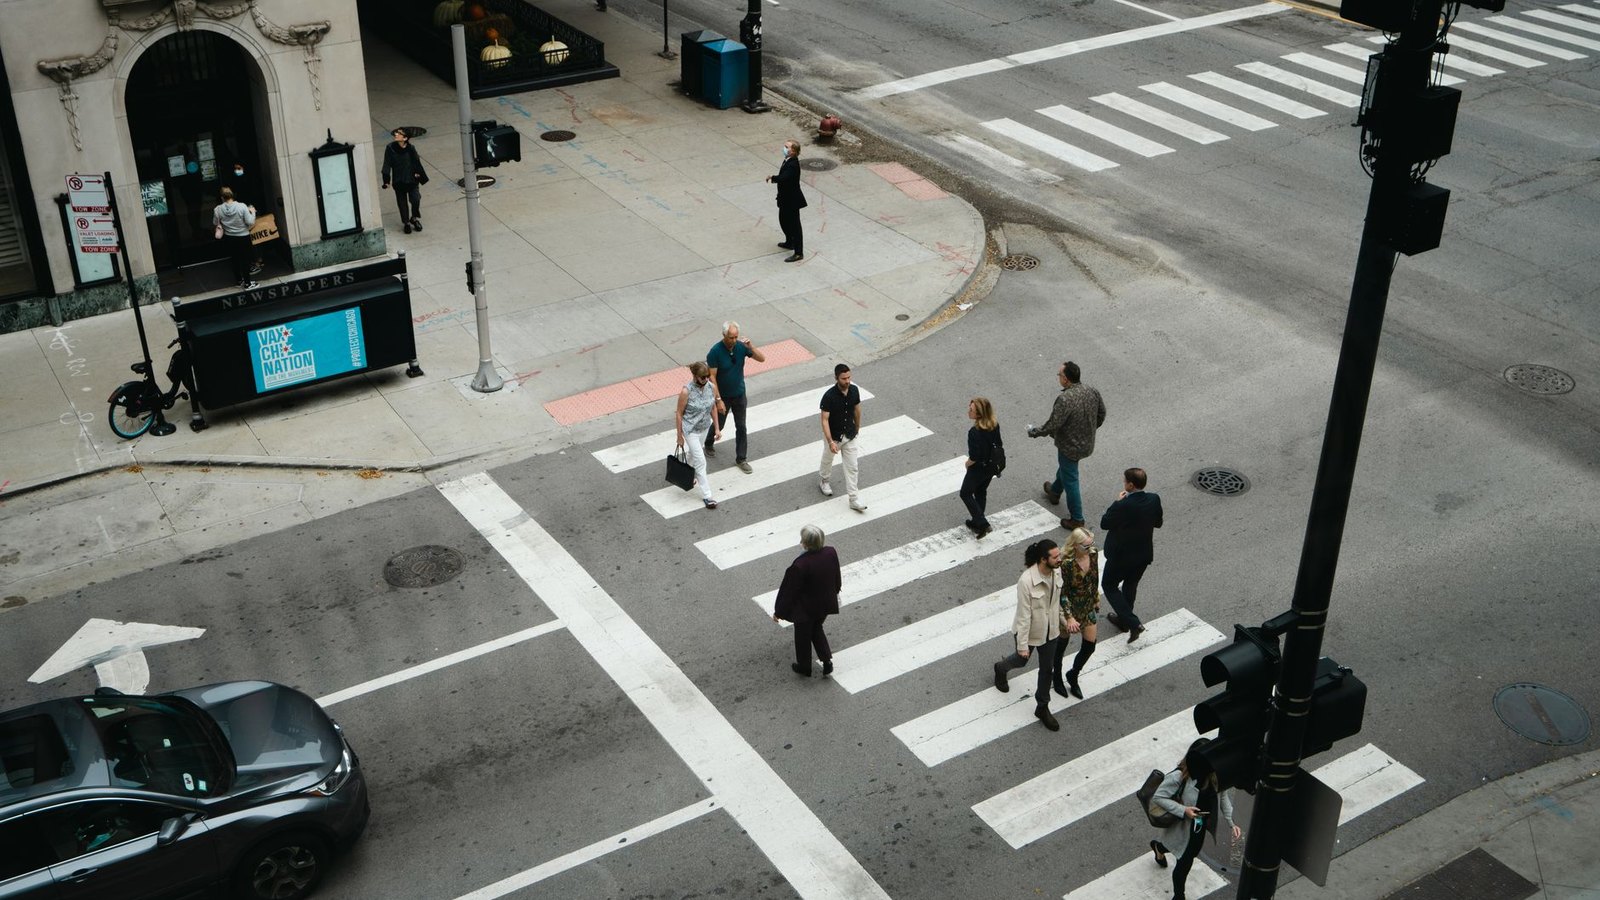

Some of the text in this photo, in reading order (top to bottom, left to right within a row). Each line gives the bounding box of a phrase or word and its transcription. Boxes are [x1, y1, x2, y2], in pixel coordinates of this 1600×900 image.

[250, 229, 268, 241] NIKE
[221, 271, 356, 310] NEWSPAPERS
[258, 327, 284, 346] VAX
[345, 309, 362, 368] #PROTECTCHICAGO
[263, 352, 312, 376] NATION
